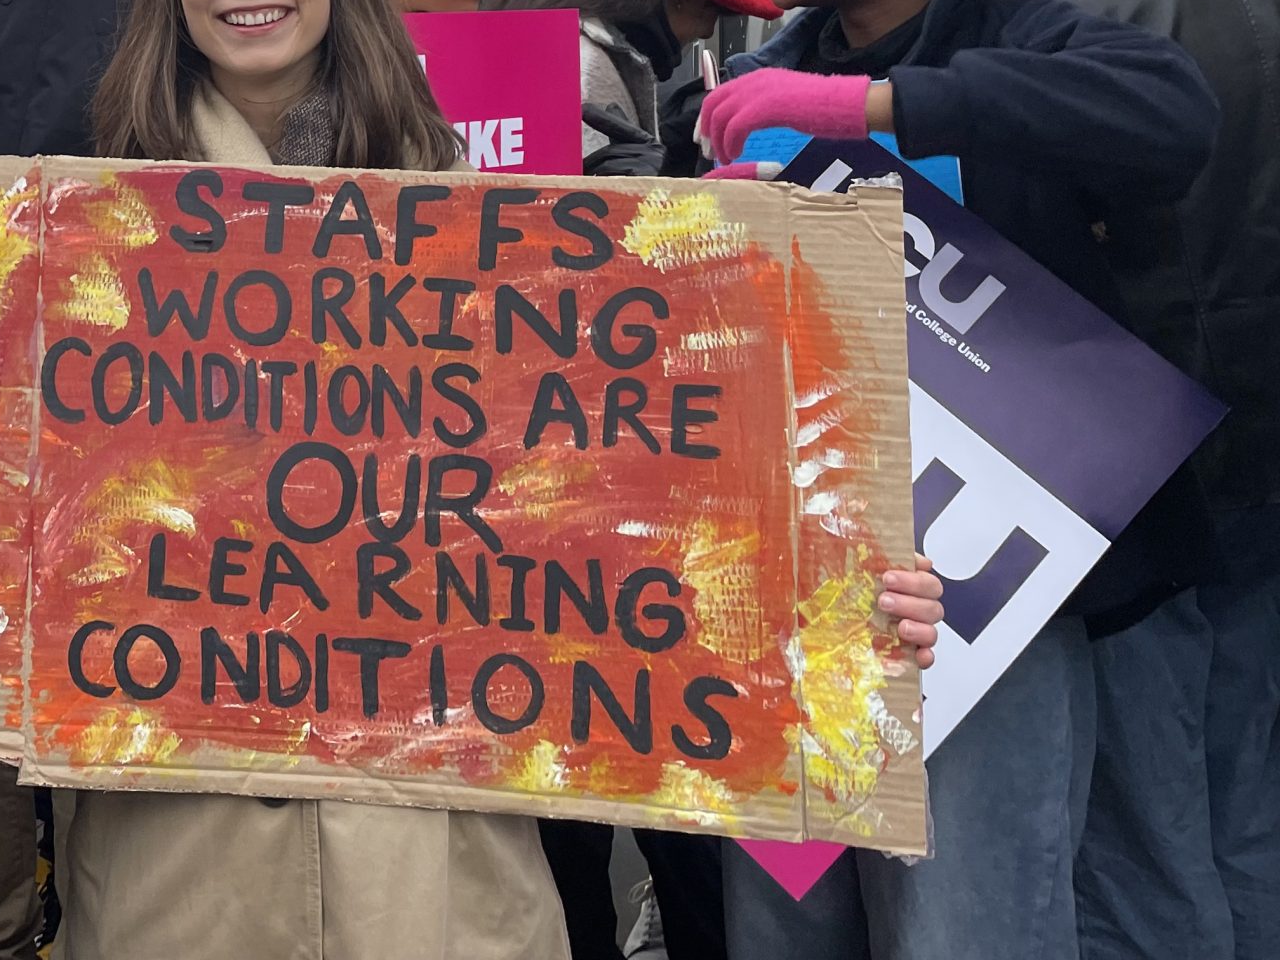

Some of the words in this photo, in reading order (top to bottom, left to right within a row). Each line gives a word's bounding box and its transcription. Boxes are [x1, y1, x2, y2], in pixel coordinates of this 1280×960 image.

[169, 169, 615, 271] STAFFS
[138, 267, 670, 370] WORKING
[915, 309, 957, 347] College
[957, 342, 991, 373] Union
[41, 337, 488, 449] CONDITIONS
[522, 371, 722, 460] ARE
[266, 442, 504, 554] OUR
[147, 533, 687, 653] LEARNING
[67, 619, 740, 760] CONDITIONS
